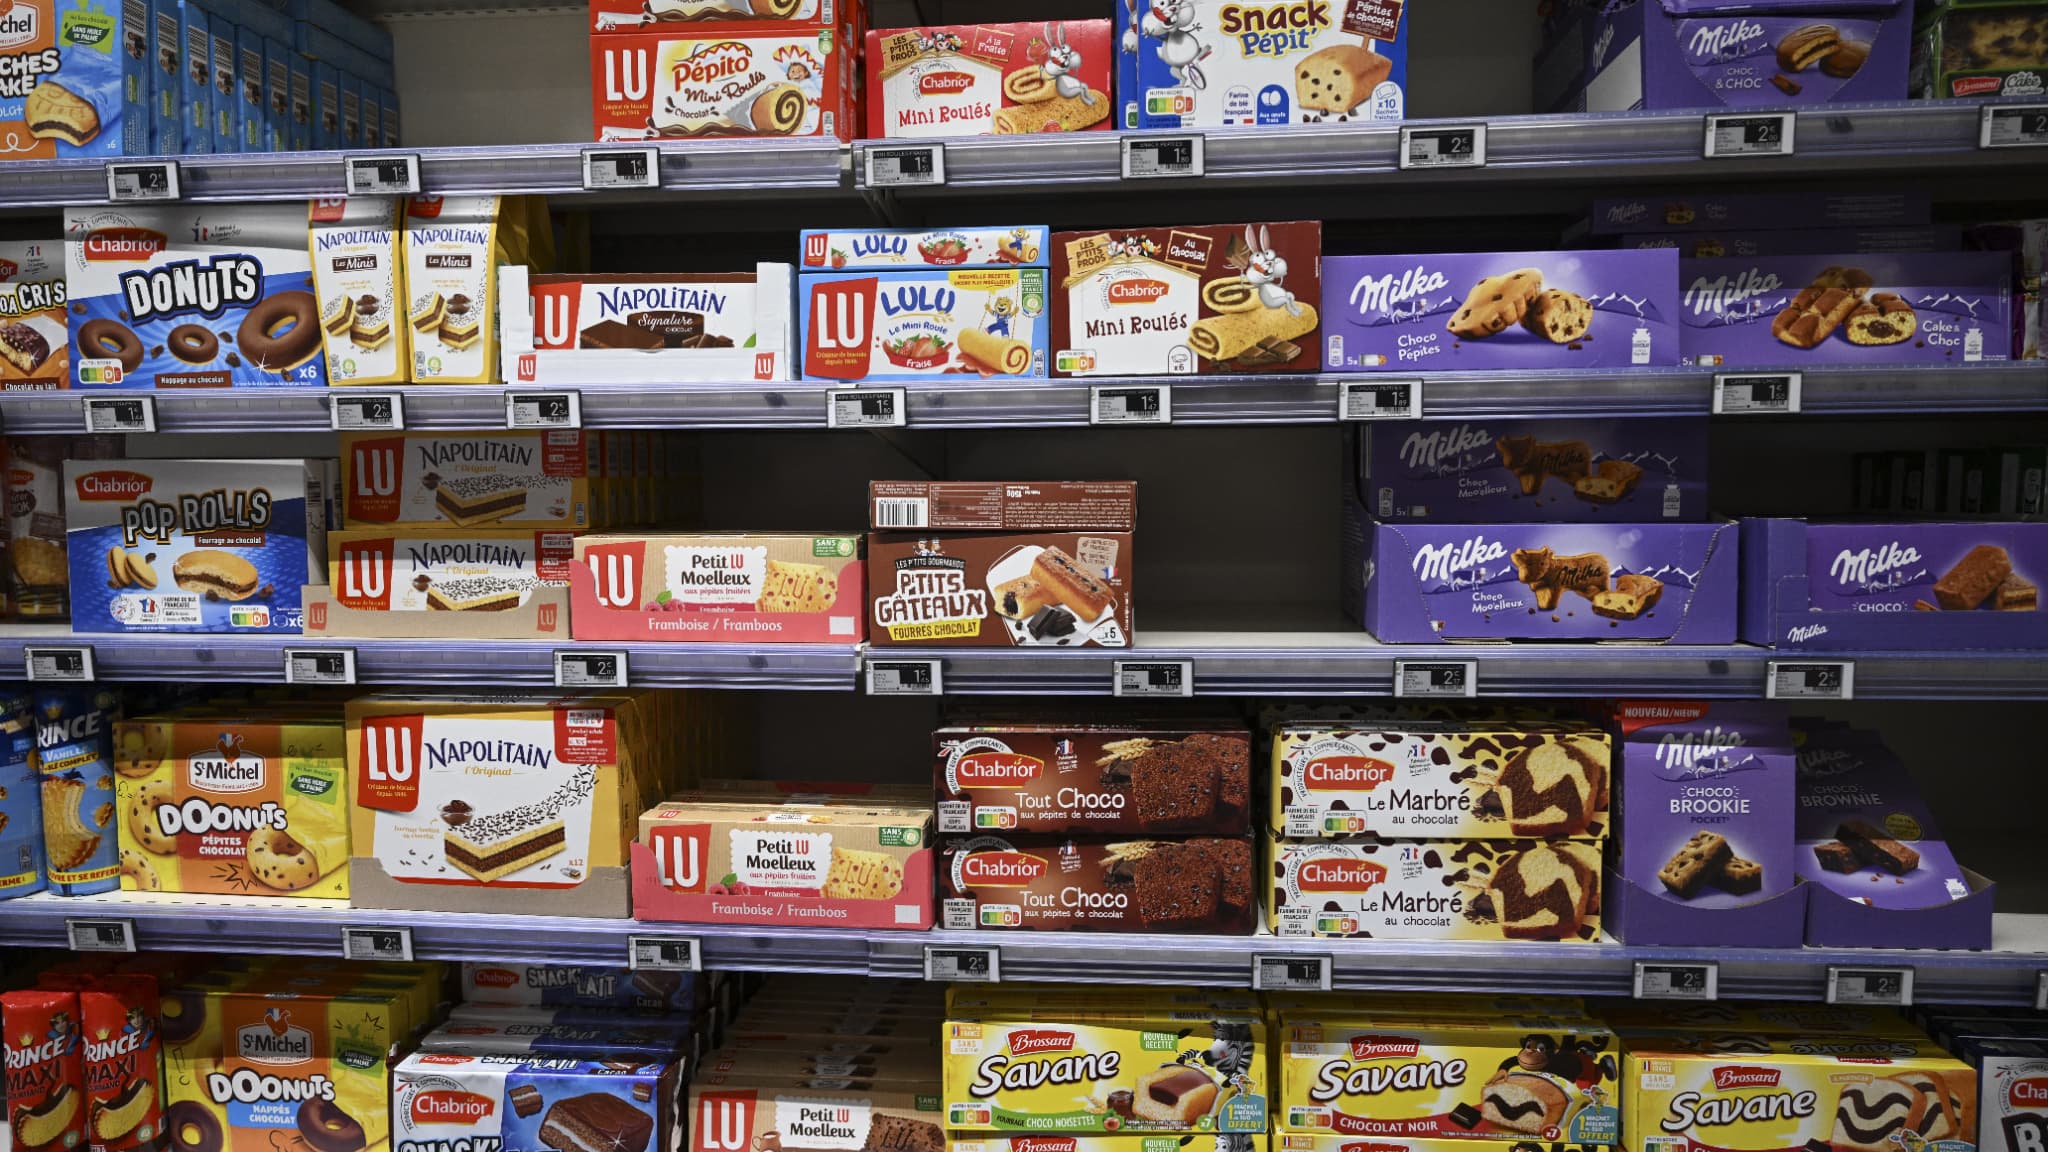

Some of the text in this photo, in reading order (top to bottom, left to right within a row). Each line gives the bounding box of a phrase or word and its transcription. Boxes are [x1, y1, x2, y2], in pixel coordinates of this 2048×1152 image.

[1223, 1, 1328, 33] Snack
[1356, 1, 1391, 16] Pépites
[1356, 12, 1395, 28] chocolat
[893, 35, 907, 46] LES
[1689, 20, 1765, 56] Milka
[605, 50, 647, 101] LU
[672, 55, 749, 91] Pépito
[1726, 67, 1753, 76] CHOC
[685, 71, 766, 105] Mini Roulés
[922, 76, 971, 89] Chabrior
[1726, 78, 1762, 88] CHOC
[674, 106, 710, 119] Chocolat
[899, 102, 991, 127] Mini Roulés
[89, 235, 158, 253] Chabrior
[317, 231, 390, 250] NAPOLITAIN
[413, 229, 487, 247] NAPOLITAIN
[807, 237, 824, 256] LU
[853, 235, 907, 257] LULU
[1079, 239, 1094, 249] LES
[1185, 239, 1196, 247] Au
[1077, 253, 1106, 268] PRODS
[1170, 245, 1205, 261] Chocolat
[126, 261, 257, 319] DONUTS
[1111, 283, 1165, 297] Chabrior
[1350, 265, 1448, 314] Milka
[1685, 268, 1782, 315] Milka
[596, 285, 727, 319] NAPOLITAIN
[881, 285, 956, 316] LULU
[818, 293, 863, 348] LU
[888, 321, 948, 336] Le Mini Roulé
[1086, 313, 1188, 338] Mini Roulés
[1398, 334, 1437, 347] Choco
[1928, 334, 1960, 347] Choc
[1398, 344, 1440, 362] Pépites
[521, 358, 534, 376] LU
[757, 357, 771, 374] LU
[907, 358, 932, 368] Fraise
[299, 367, 317, 379] x6
[5, 383, 32, 391] Chocolat
[418, 441, 533, 469] NAPOLITAIN
[1400, 425, 1493, 468] Milka
[356, 448, 395, 496] LU
[83, 477, 147, 495] Chabrior
[126, 492, 270, 544] POP ROLLS
[198, 536, 225, 545] Fourrage
[236, 536, 261, 544] chocolat
[409, 543, 526, 572] NAPOLITAIN
[692, 554, 743, 570] Petit LU
[1413, 536, 1507, 581] Milka
[1830, 541, 1921, 585] Milka
[344, 550, 385, 598] LU
[681, 571, 751, 586] Moelleux
[1472, 592, 1503, 601] Choco
[879, 593, 985, 623] GÂTEAUX
[1859, 603, 1901, 612] CHOCO
[539, 608, 556, 626] LU
[648, 618, 709, 631] Framboise
[723, 618, 782, 631] Framboos
[893, 622, 977, 639] FOURRÉS CHOCOLAT
[1787, 623, 1829, 643] Milka
[367, 726, 413, 781] LU
[424, 738, 552, 770] NAPOLITAIN
[1655, 726, 1746, 769] Milka
[206, 761, 259, 780] Michel
[465, 765, 512, 777] l'Original
[961, 761, 1036, 777] Chabrior
[1309, 763, 1387, 781] Chabrior
[1015, 788, 1125, 808] Tout Choco
[1367, 789, 1470, 811] Le Marbré
[1686, 787, 1733, 797] CHOCO
[1020, 810, 1120, 820] aux pépites de chocolat
[1670, 800, 1750, 814] BROOKIE
[158, 799, 287, 833] DOONUTS
[1392, 813, 1459, 825] au chocolat
[881, 827, 902, 835] SANS
[202, 834, 242, 846] PÉPITES
[757, 839, 809, 854] Petit LU
[199, 846, 246, 856] CHOCOLAT
[655, 835, 699, 887] LU
[746, 855, 816, 871] Moelleux
[966, 859, 1040, 876] Chabrior
[750, 872, 764, 880] aux
[765, 872, 788, 881] pépites
[1302, 866, 1379, 882] Chabrior
[1020, 888, 1128, 908] Tout Choco
[1360, 891, 1462, 913] Le Marbré
[712, 902, 774, 916] Framboise
[787, 904, 847, 918] Framboos
[1042, 910, 1071, 919] pépites
[1074, 910, 1084, 918] de
[1088, 910, 1124, 919] chocolat
[1384, 916, 1451, 927] au chocolat
[254, 1034, 307, 1054] Michel
[1013, 1034, 1073, 1050] Brossard
[1144, 1032, 1175, 1041] NOUVELLE
[1145, 1041, 1173, 1049] RECETTE
[3, 1037, 66, 1069] PRINCE
[83, 1030, 140, 1063] PRINCE
[1356, 1042, 1416, 1056] Brossard
[971, 1051, 1119, 1096] Savane
[1310, 1058, 1467, 1100] Savane
[1718, 1070, 1777, 1086] Brossard
[210, 1071, 335, 1103] DOONUTS
[417, 1096, 488, 1116] Chabrior
[800, 1107, 849, 1122] Petit LU
[1661, 1090, 1817, 1132] Savane
[249, 1114, 295, 1125] CHOCOLAT
[703, 1099, 744, 1150] LU
[1227, 1119, 1262, 1130] OFFERT
[1339, 1117, 1438, 1134] CHOCOLAT NOIR
[790, 1121, 855, 1138] Moelleux
[1578, 1131, 1615, 1141] OFFERT
